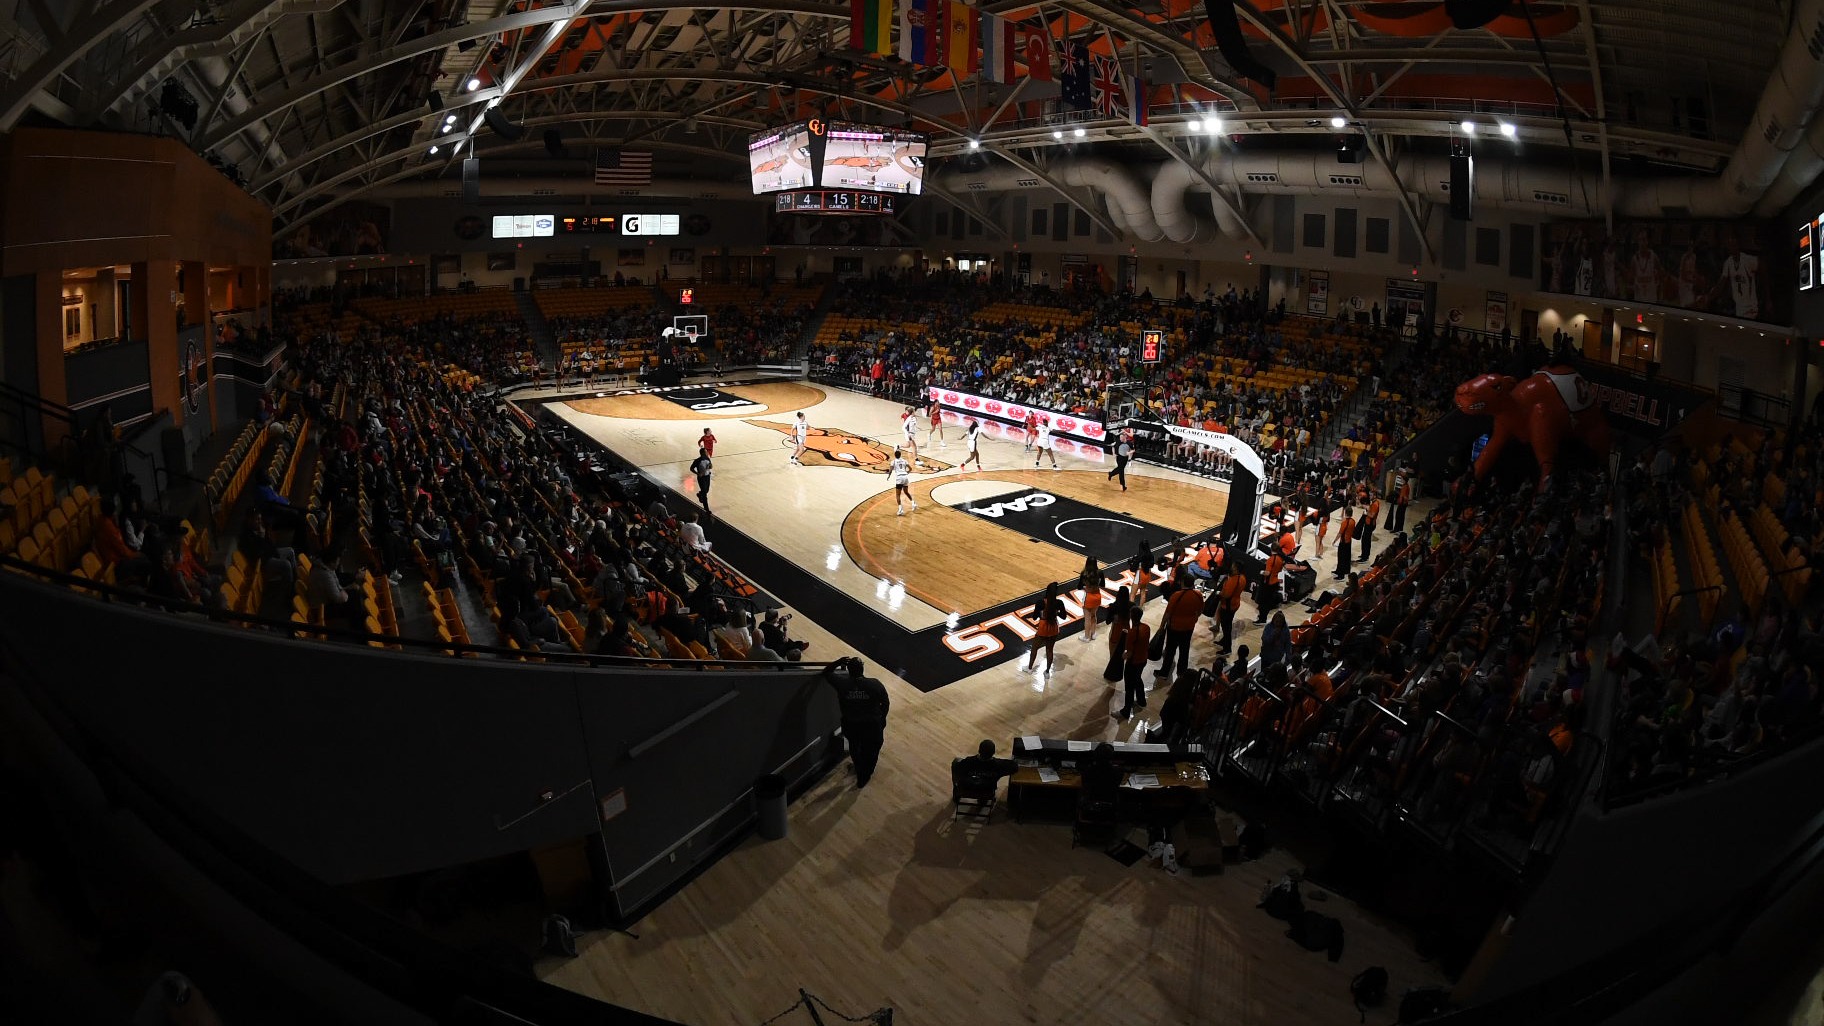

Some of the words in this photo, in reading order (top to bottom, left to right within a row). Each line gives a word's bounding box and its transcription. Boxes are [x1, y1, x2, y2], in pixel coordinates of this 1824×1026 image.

[803, 193, 811, 205] 4
[832, 193, 848, 205] 15
[860, 194, 878, 205] 2:18
[625, 216, 639, 233] G
[968, 493, 1057, 518] CAA
